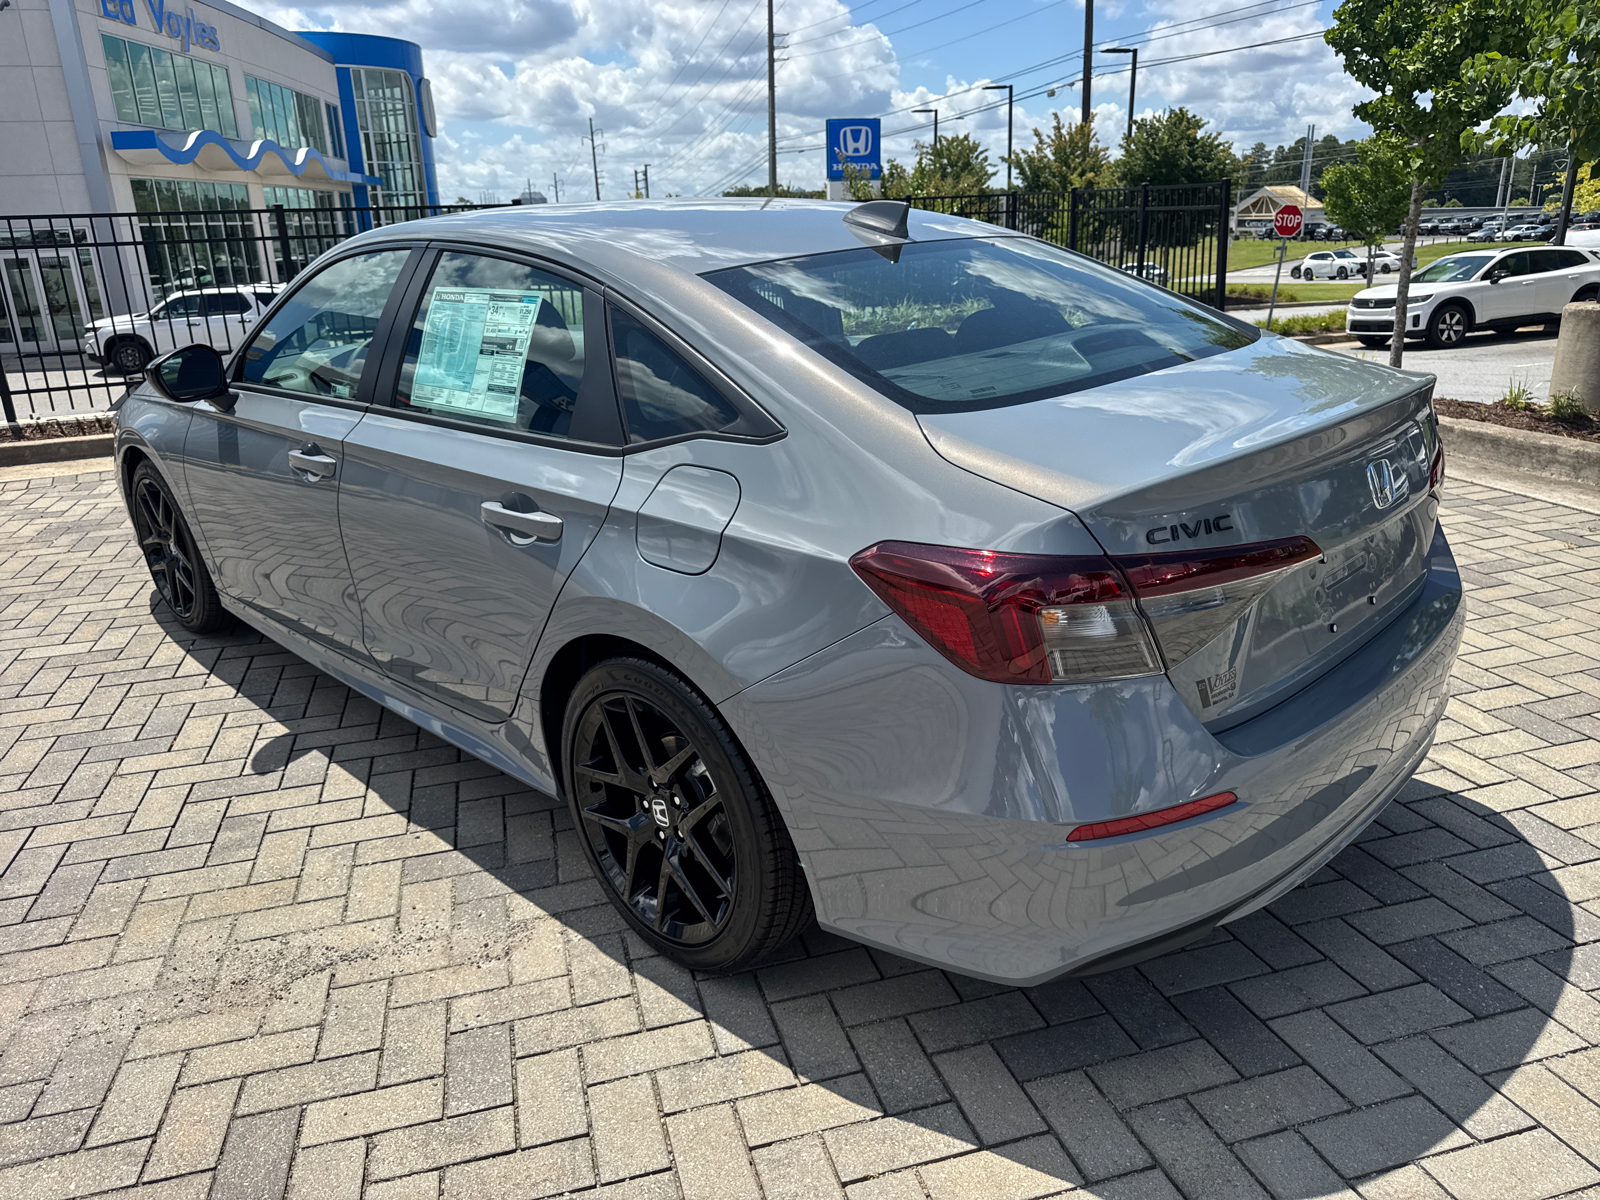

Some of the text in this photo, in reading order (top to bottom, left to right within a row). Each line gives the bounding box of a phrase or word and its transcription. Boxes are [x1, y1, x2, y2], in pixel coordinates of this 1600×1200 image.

[147, 0, 220, 52] Voyles
[1275, 214, 1301, 227] STOP
[441, 293, 464, 301] HONDA
[490, 305, 499, 315] 34
[1146, 514, 1234, 544] CIVIC
[623, 673, 711, 747] GOODYEAR
